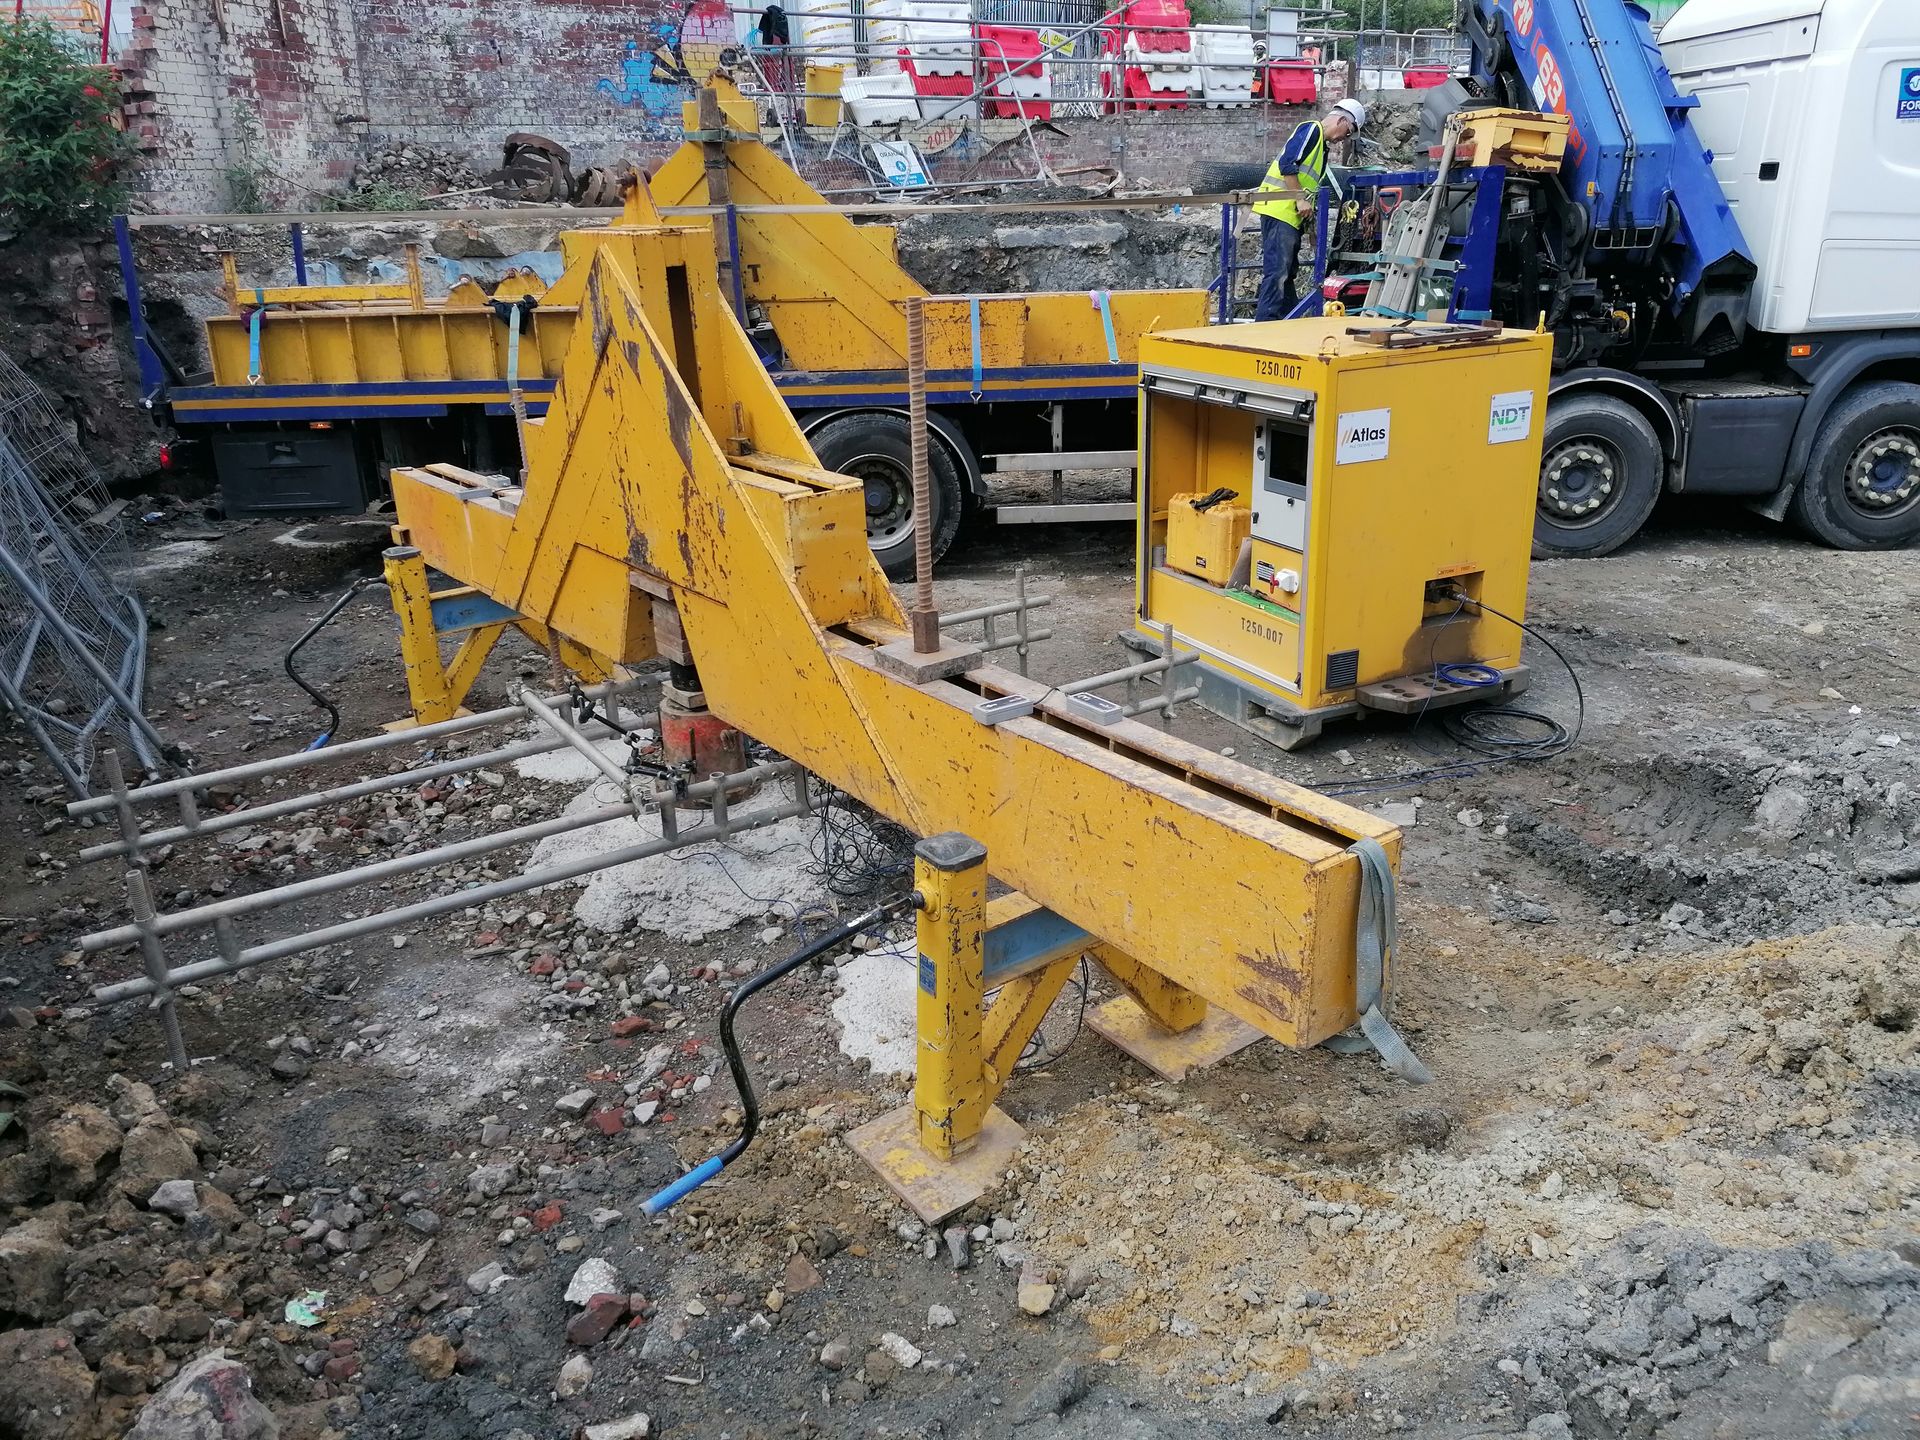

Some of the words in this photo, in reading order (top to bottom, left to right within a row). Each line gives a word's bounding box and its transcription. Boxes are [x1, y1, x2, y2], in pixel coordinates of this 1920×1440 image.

[747, 264, 761, 282] T
[1256, 359, 1302, 380] T250.007
[1491, 406, 1530, 426] NDT
[1350, 428, 1386, 443] Atlas
[1241, 617, 1283, 645] T250.007
